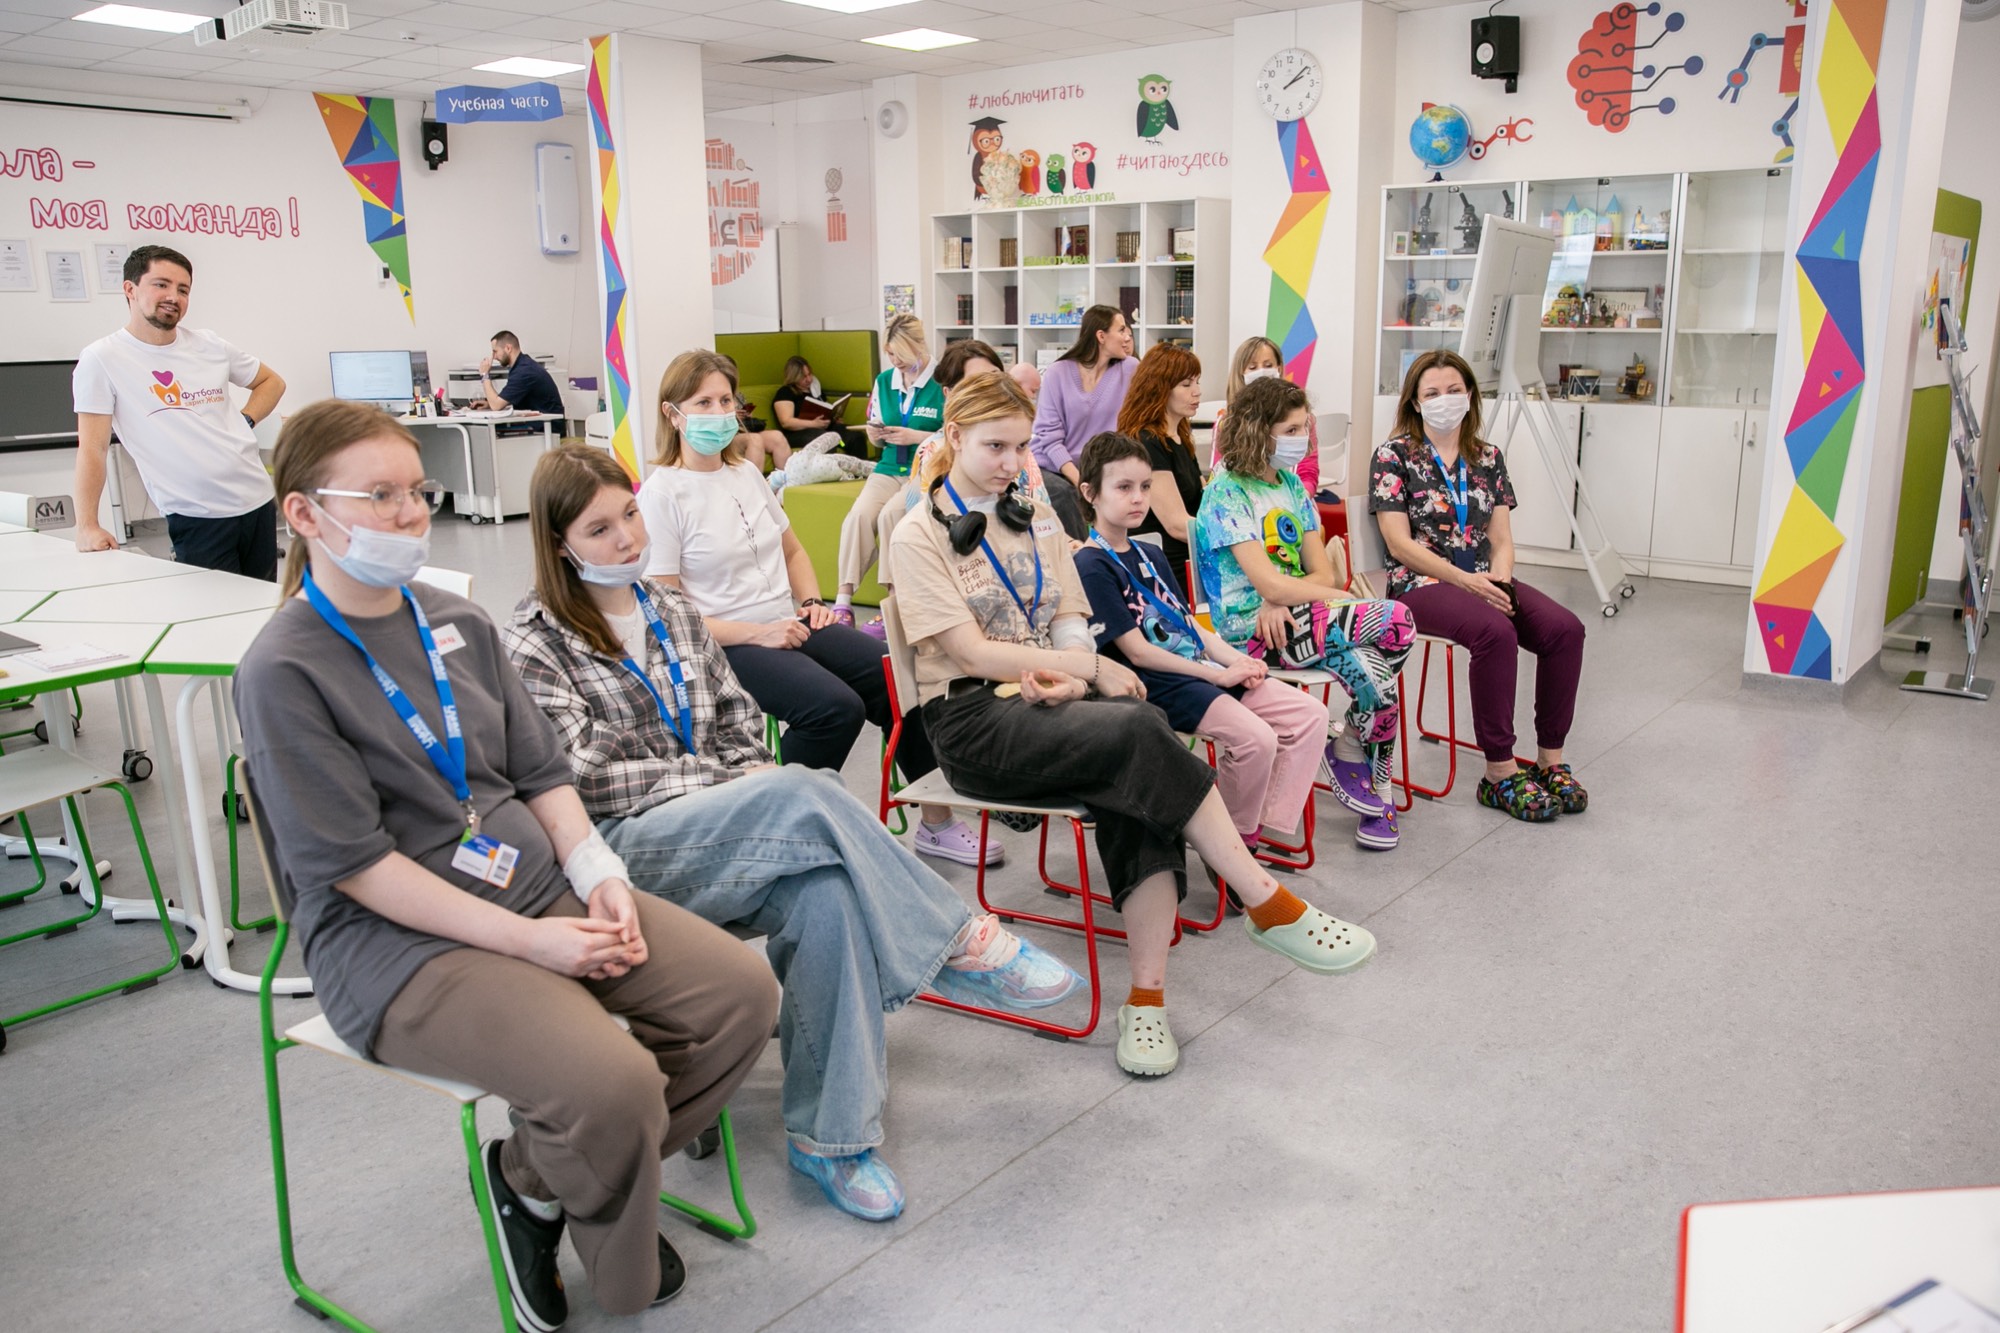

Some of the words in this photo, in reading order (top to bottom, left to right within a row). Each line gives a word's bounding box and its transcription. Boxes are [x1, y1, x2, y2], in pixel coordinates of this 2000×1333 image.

[1275, 59, 1283, 68] 11
[1286, 55, 1294, 64] 12
[1268, 69, 1276, 78] 10
[1263, 83, 1270, 91] 9
[1309, 79, 1315, 87] 3
[967, 83, 1085, 110] #люблючитать
[1266, 94, 1272, 103] 8
[1305, 91, 1311, 99] 4
[448, 96, 505, 113] Учебная
[511, 96, 550, 109] часть
[1274, 103, 1280, 111] 7
[1298, 101, 1303, 110] 5
[1284, 106, 1290, 115] 6
[1117, 152, 1229, 177] #читаюздесь
[167, 394, 175, 403] 1
[1329, 777, 1351, 805] crocs
